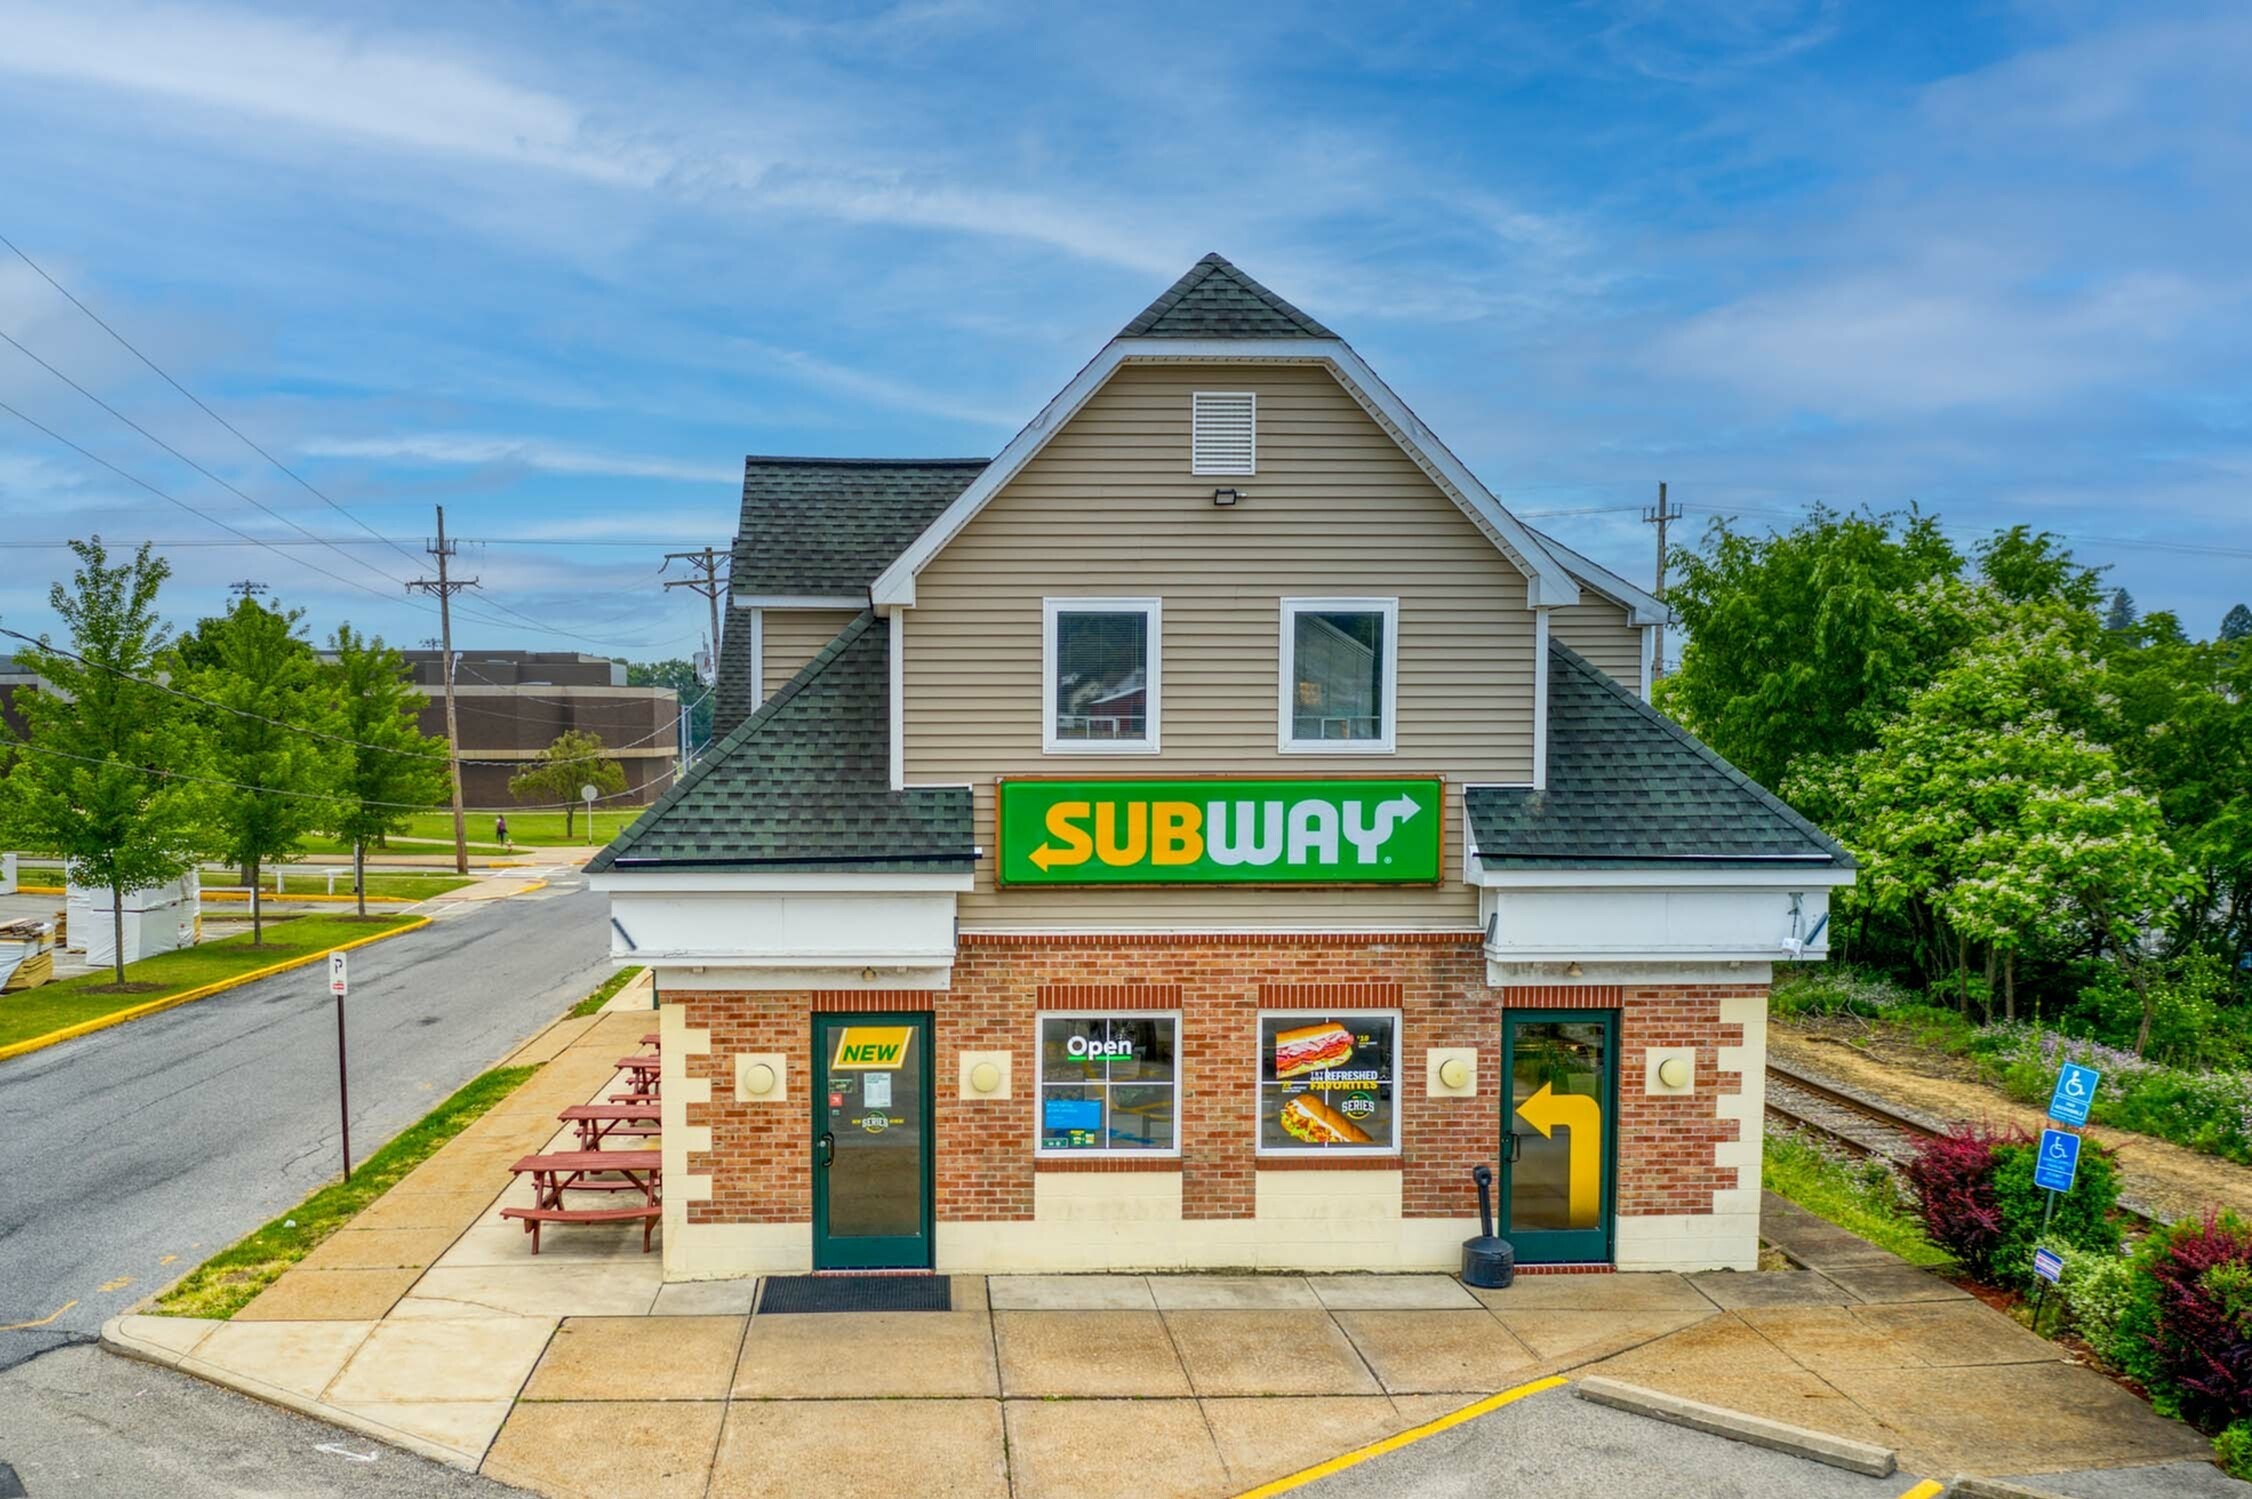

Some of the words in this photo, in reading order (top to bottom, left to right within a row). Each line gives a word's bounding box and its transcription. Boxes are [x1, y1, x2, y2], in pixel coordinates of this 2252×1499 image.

[1029, 793, 1421, 872] SUBWAY
[843, 1044, 899, 1061] NEW
[1067, 1035, 1132, 1060] Open
[1325, 1070, 1378, 1081] REFRESHED
[1310, 1081, 1378, 1090] FAVORITES
[1341, 1099, 1375, 1113] SERIES
